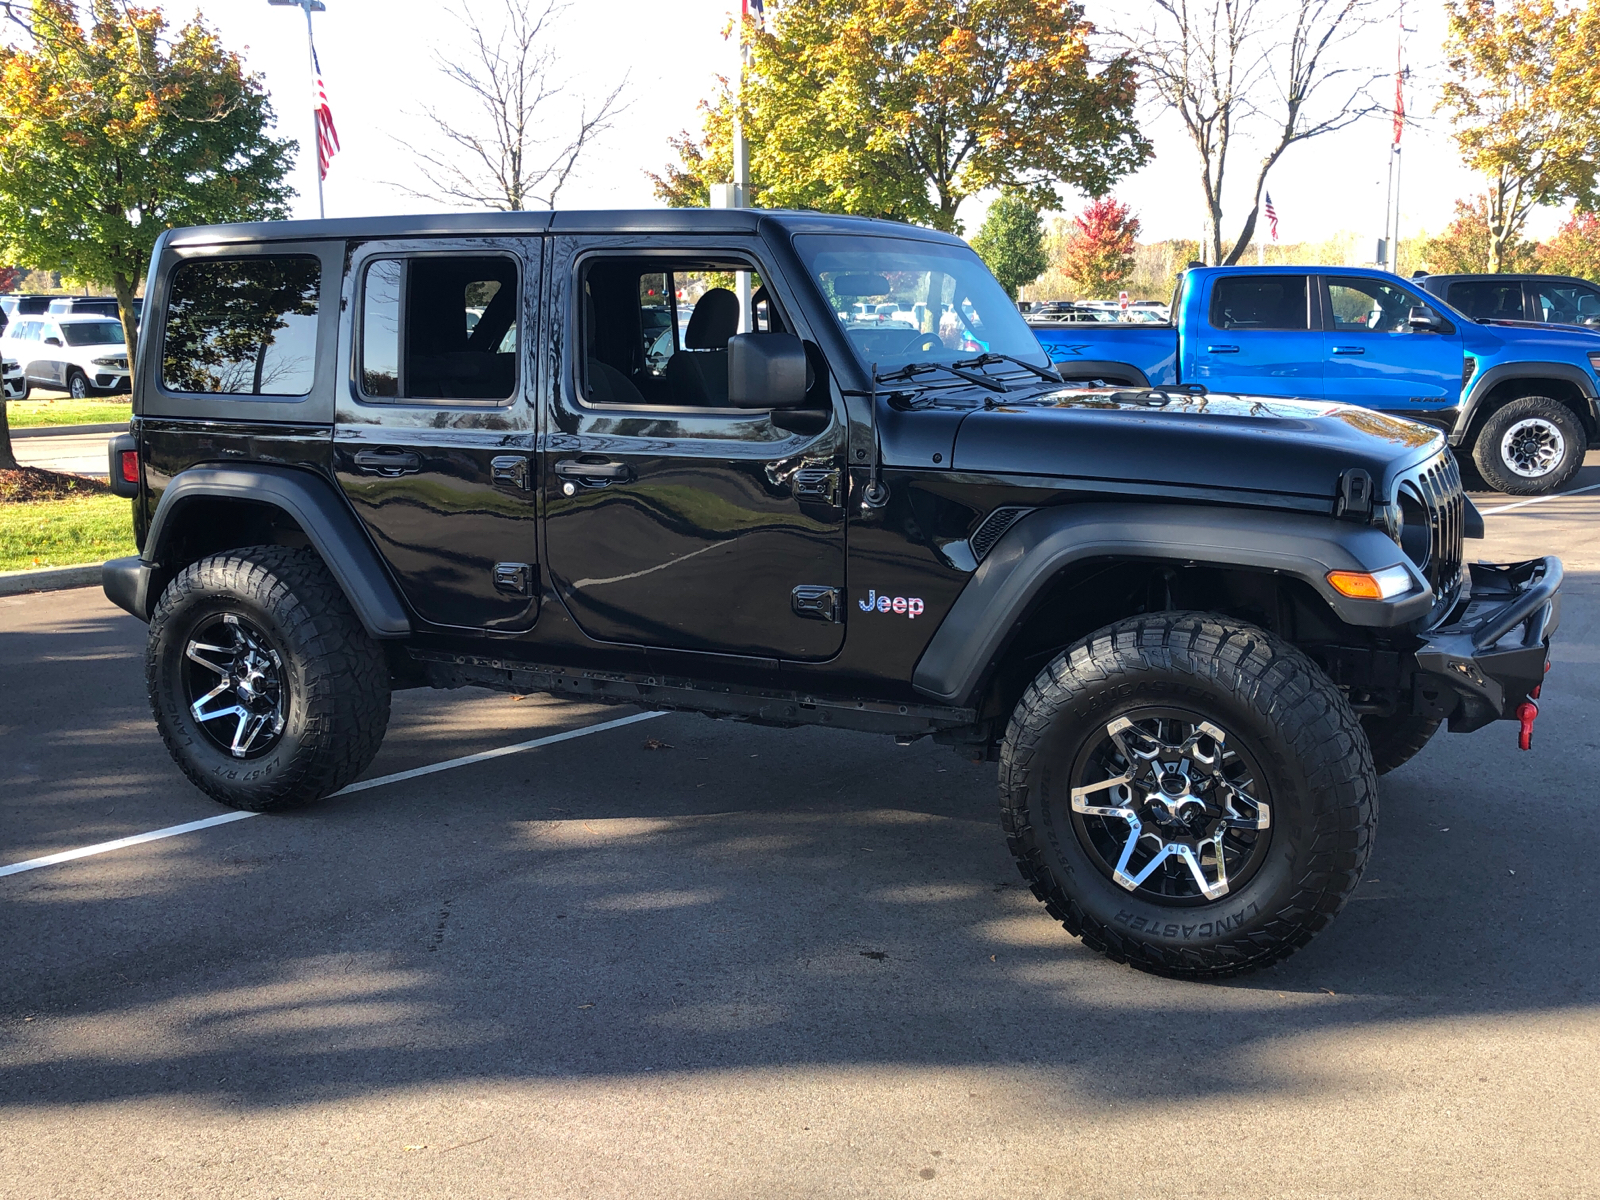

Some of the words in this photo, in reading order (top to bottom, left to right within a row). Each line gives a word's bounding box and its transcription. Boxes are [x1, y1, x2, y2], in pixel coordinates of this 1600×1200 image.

[858, 589, 924, 619] Jeep
[1073, 680, 1218, 718] LANCASTER
[211, 766, 239, 780] R/T
[1114, 901, 1261, 940] LANCASTER
